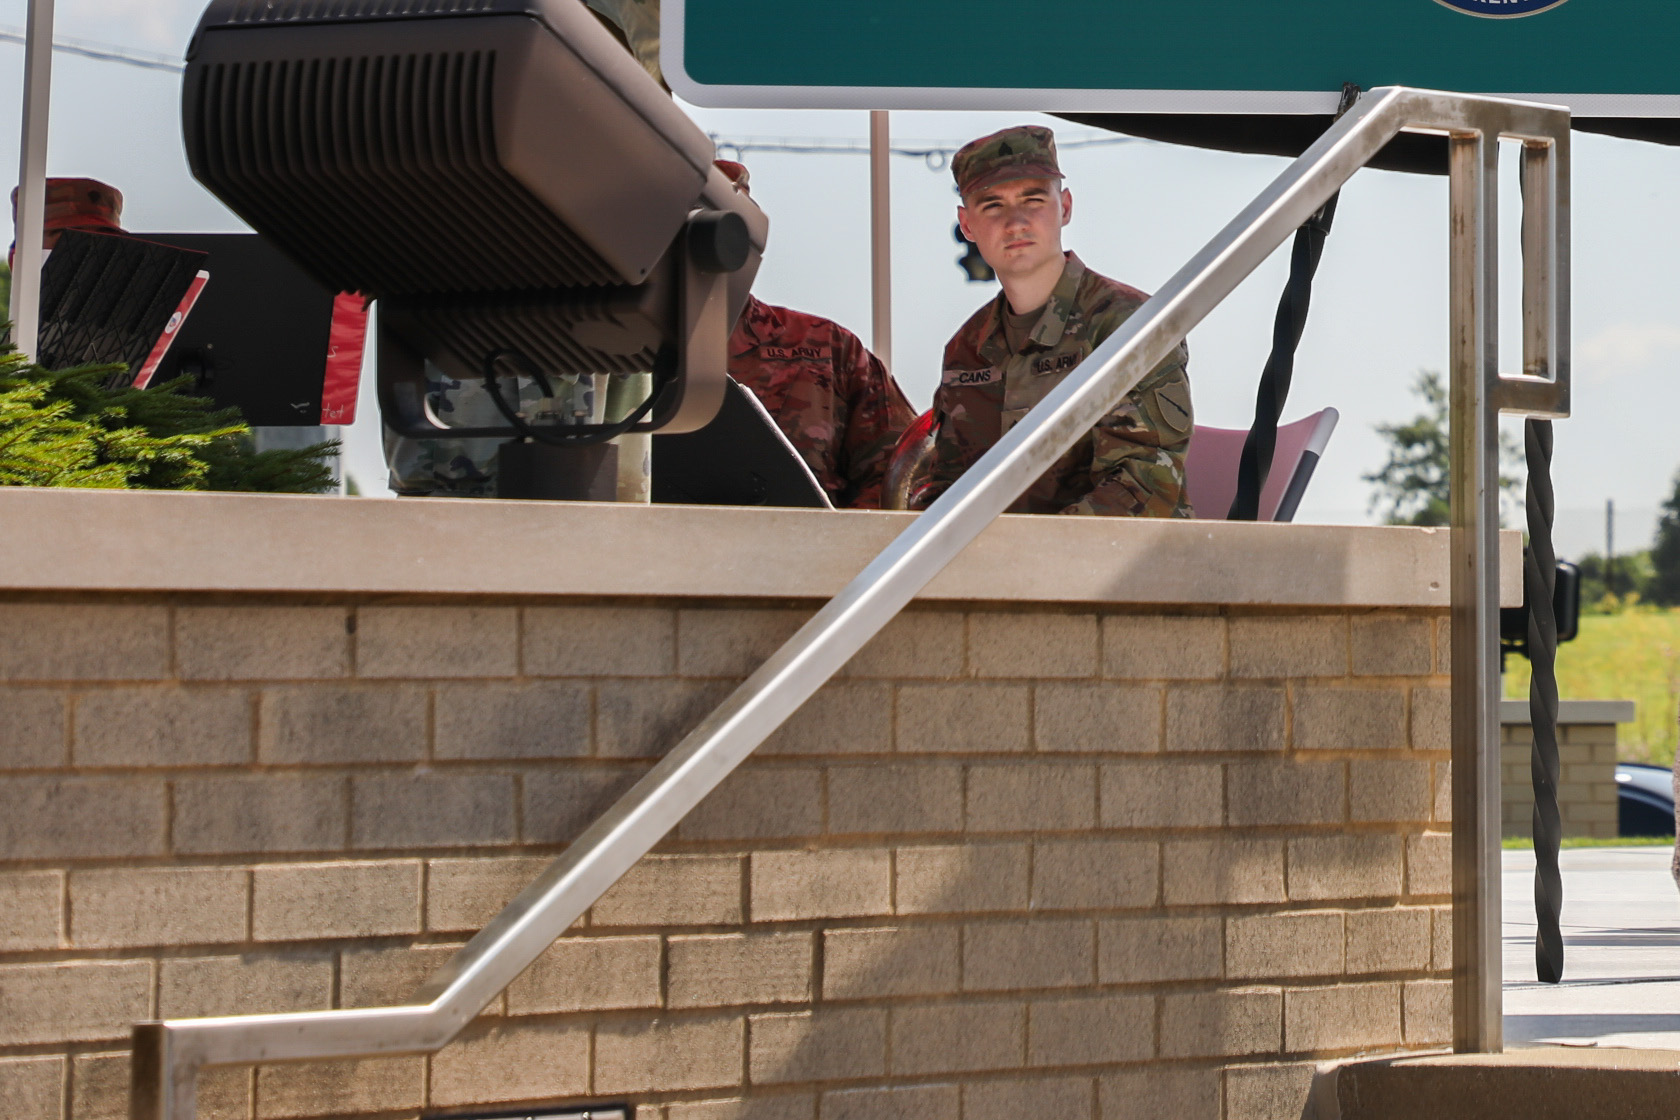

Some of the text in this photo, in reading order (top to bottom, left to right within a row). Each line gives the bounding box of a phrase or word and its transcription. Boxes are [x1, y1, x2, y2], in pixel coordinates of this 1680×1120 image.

[766, 347, 822, 358] U.S. ARMY
[958, 370, 992, 383] CAINS
